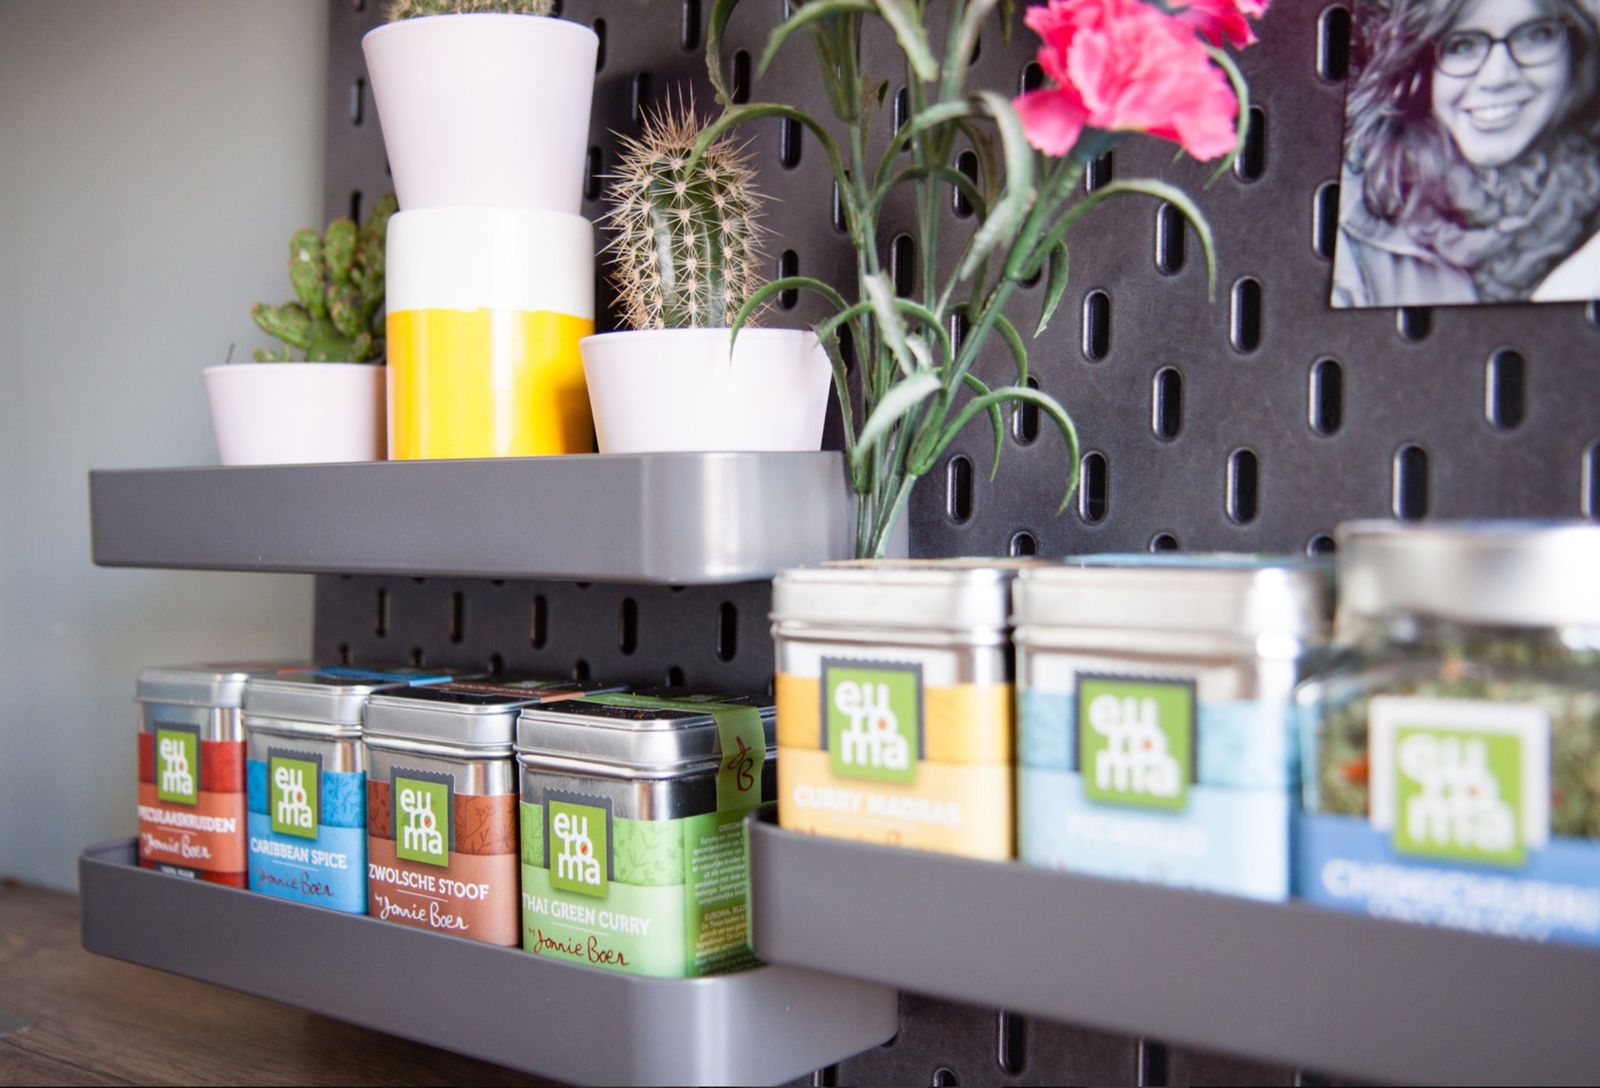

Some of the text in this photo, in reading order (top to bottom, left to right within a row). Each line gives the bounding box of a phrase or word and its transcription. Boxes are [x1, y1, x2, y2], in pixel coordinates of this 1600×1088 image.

[251, 837, 348, 870] CARIBBEAN SPICE
[368, 863, 490, 900] ZWOLSCHE STOOF
[522, 893, 651, 935] THAI GREEN CURRY
